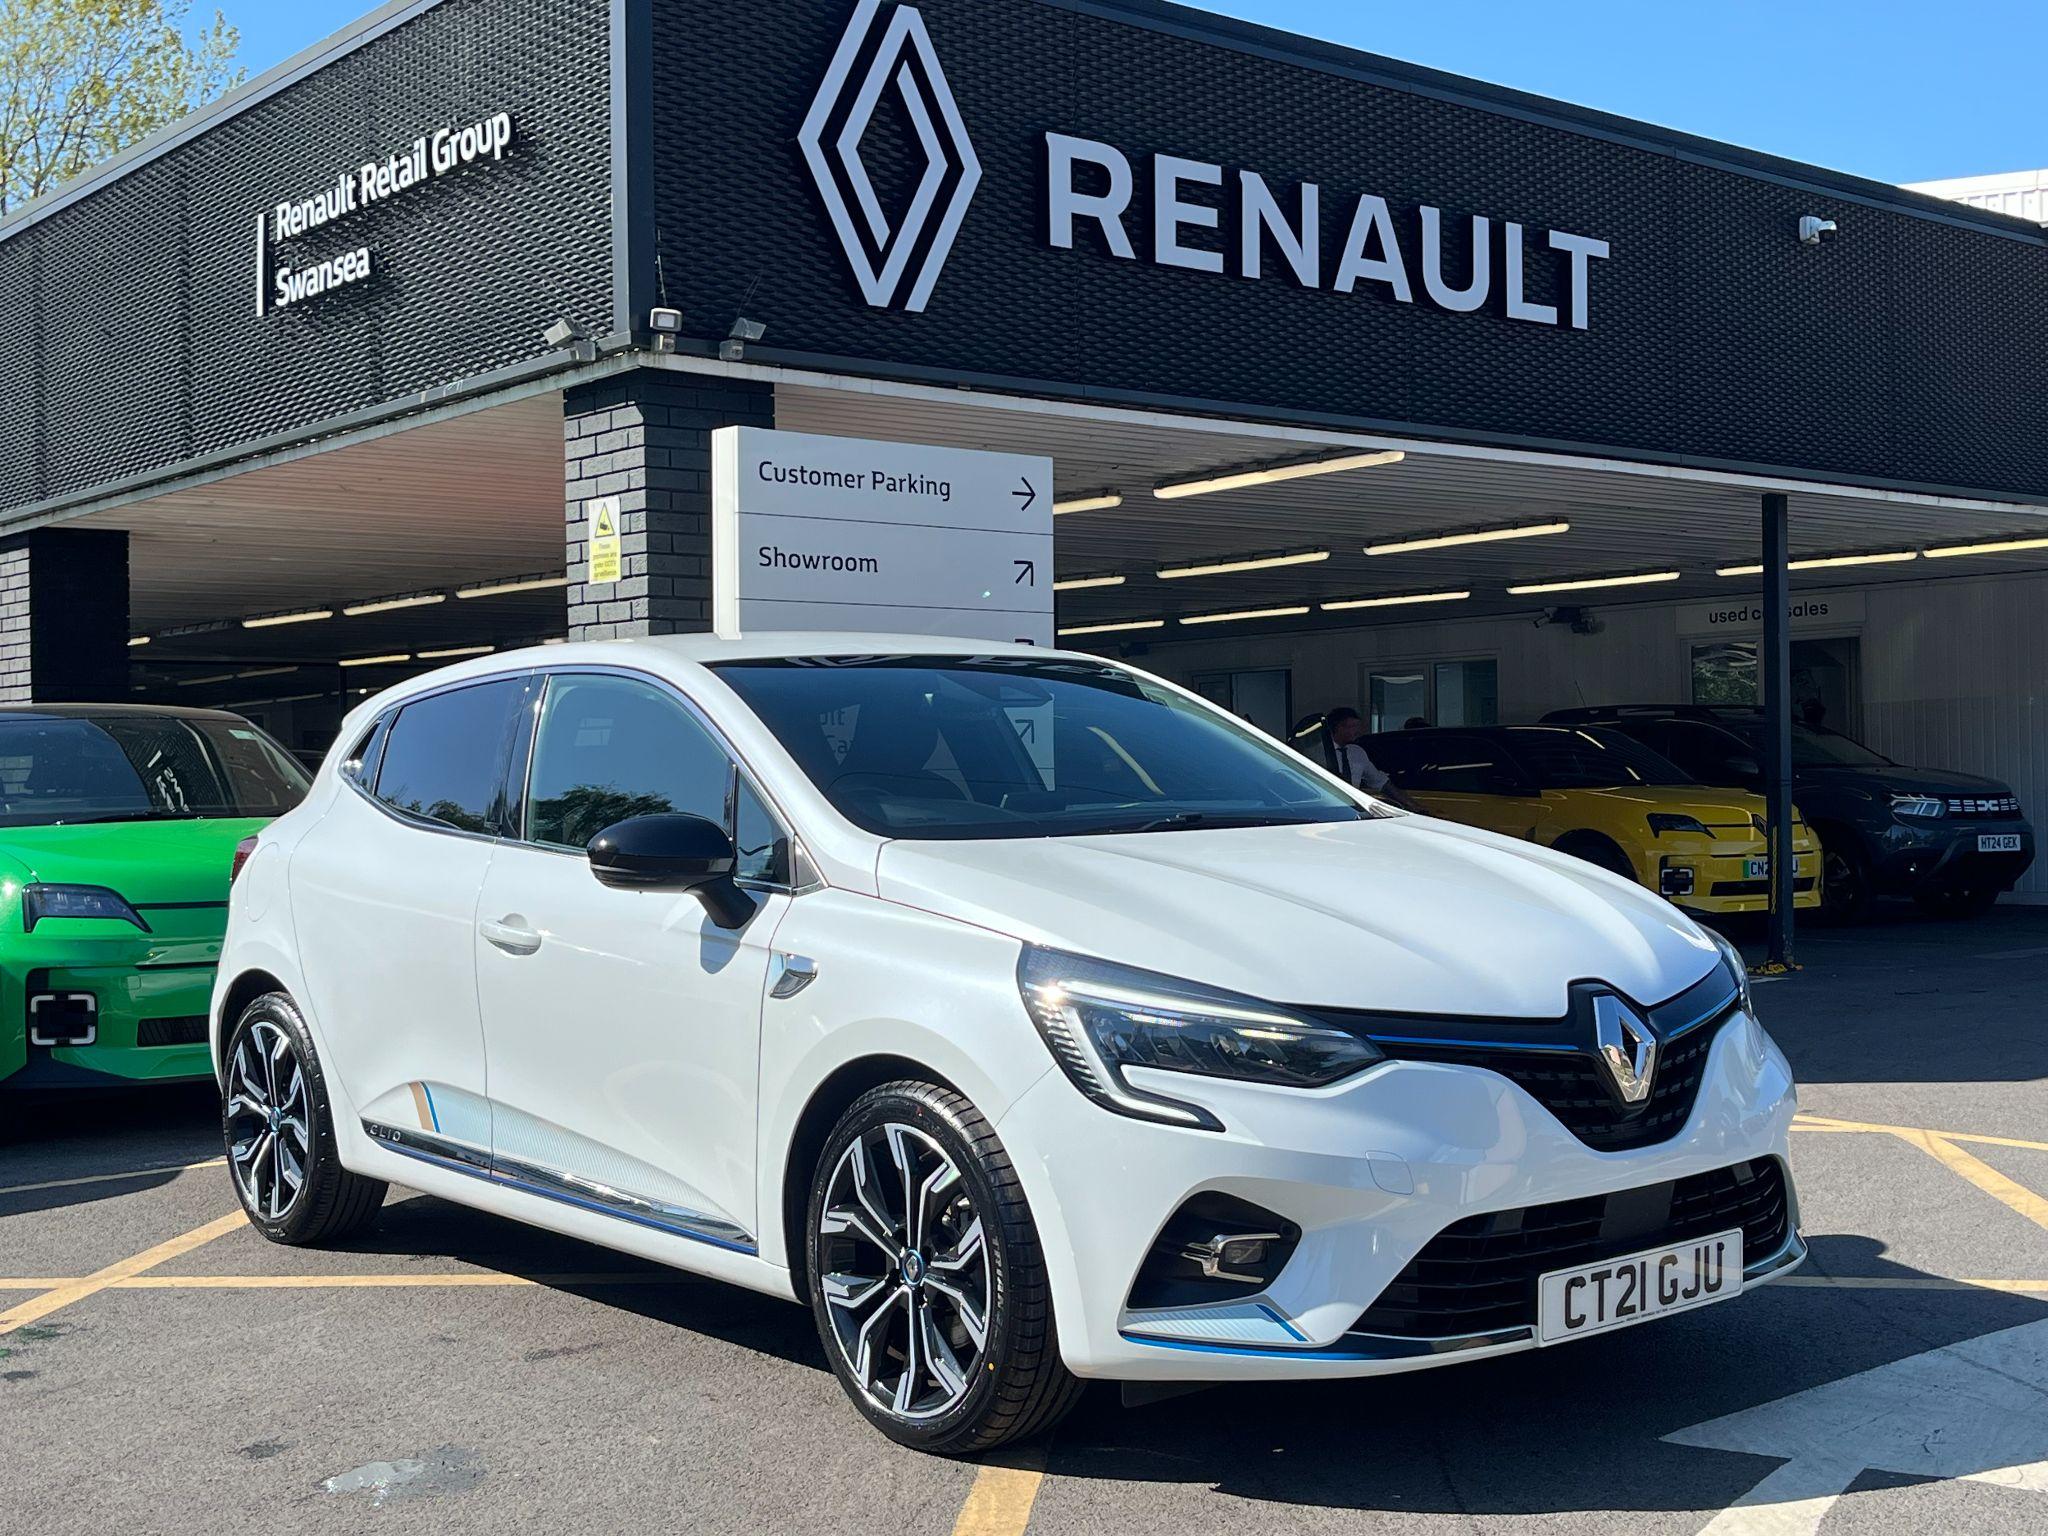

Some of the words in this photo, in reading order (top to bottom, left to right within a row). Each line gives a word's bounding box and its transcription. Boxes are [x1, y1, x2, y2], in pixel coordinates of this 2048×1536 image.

[274, 173, 357, 240] Renault
[361, 137, 428, 205] Retail
[431, 113, 511, 173] Group
[1045, 131, 1611, 330] RENAULT
[275, 247, 371, 307] Swansea
[758, 460, 866, 489] Customer
[871, 470, 951, 501] Parking
[758, 546, 879, 573] Showroom
[1709, 606, 1748, 624] used
[370, 1124, 402, 1142] CLIO
[1564, 1260, 1646, 1330] CT21
[1658, 1241, 1725, 1307] GJU
